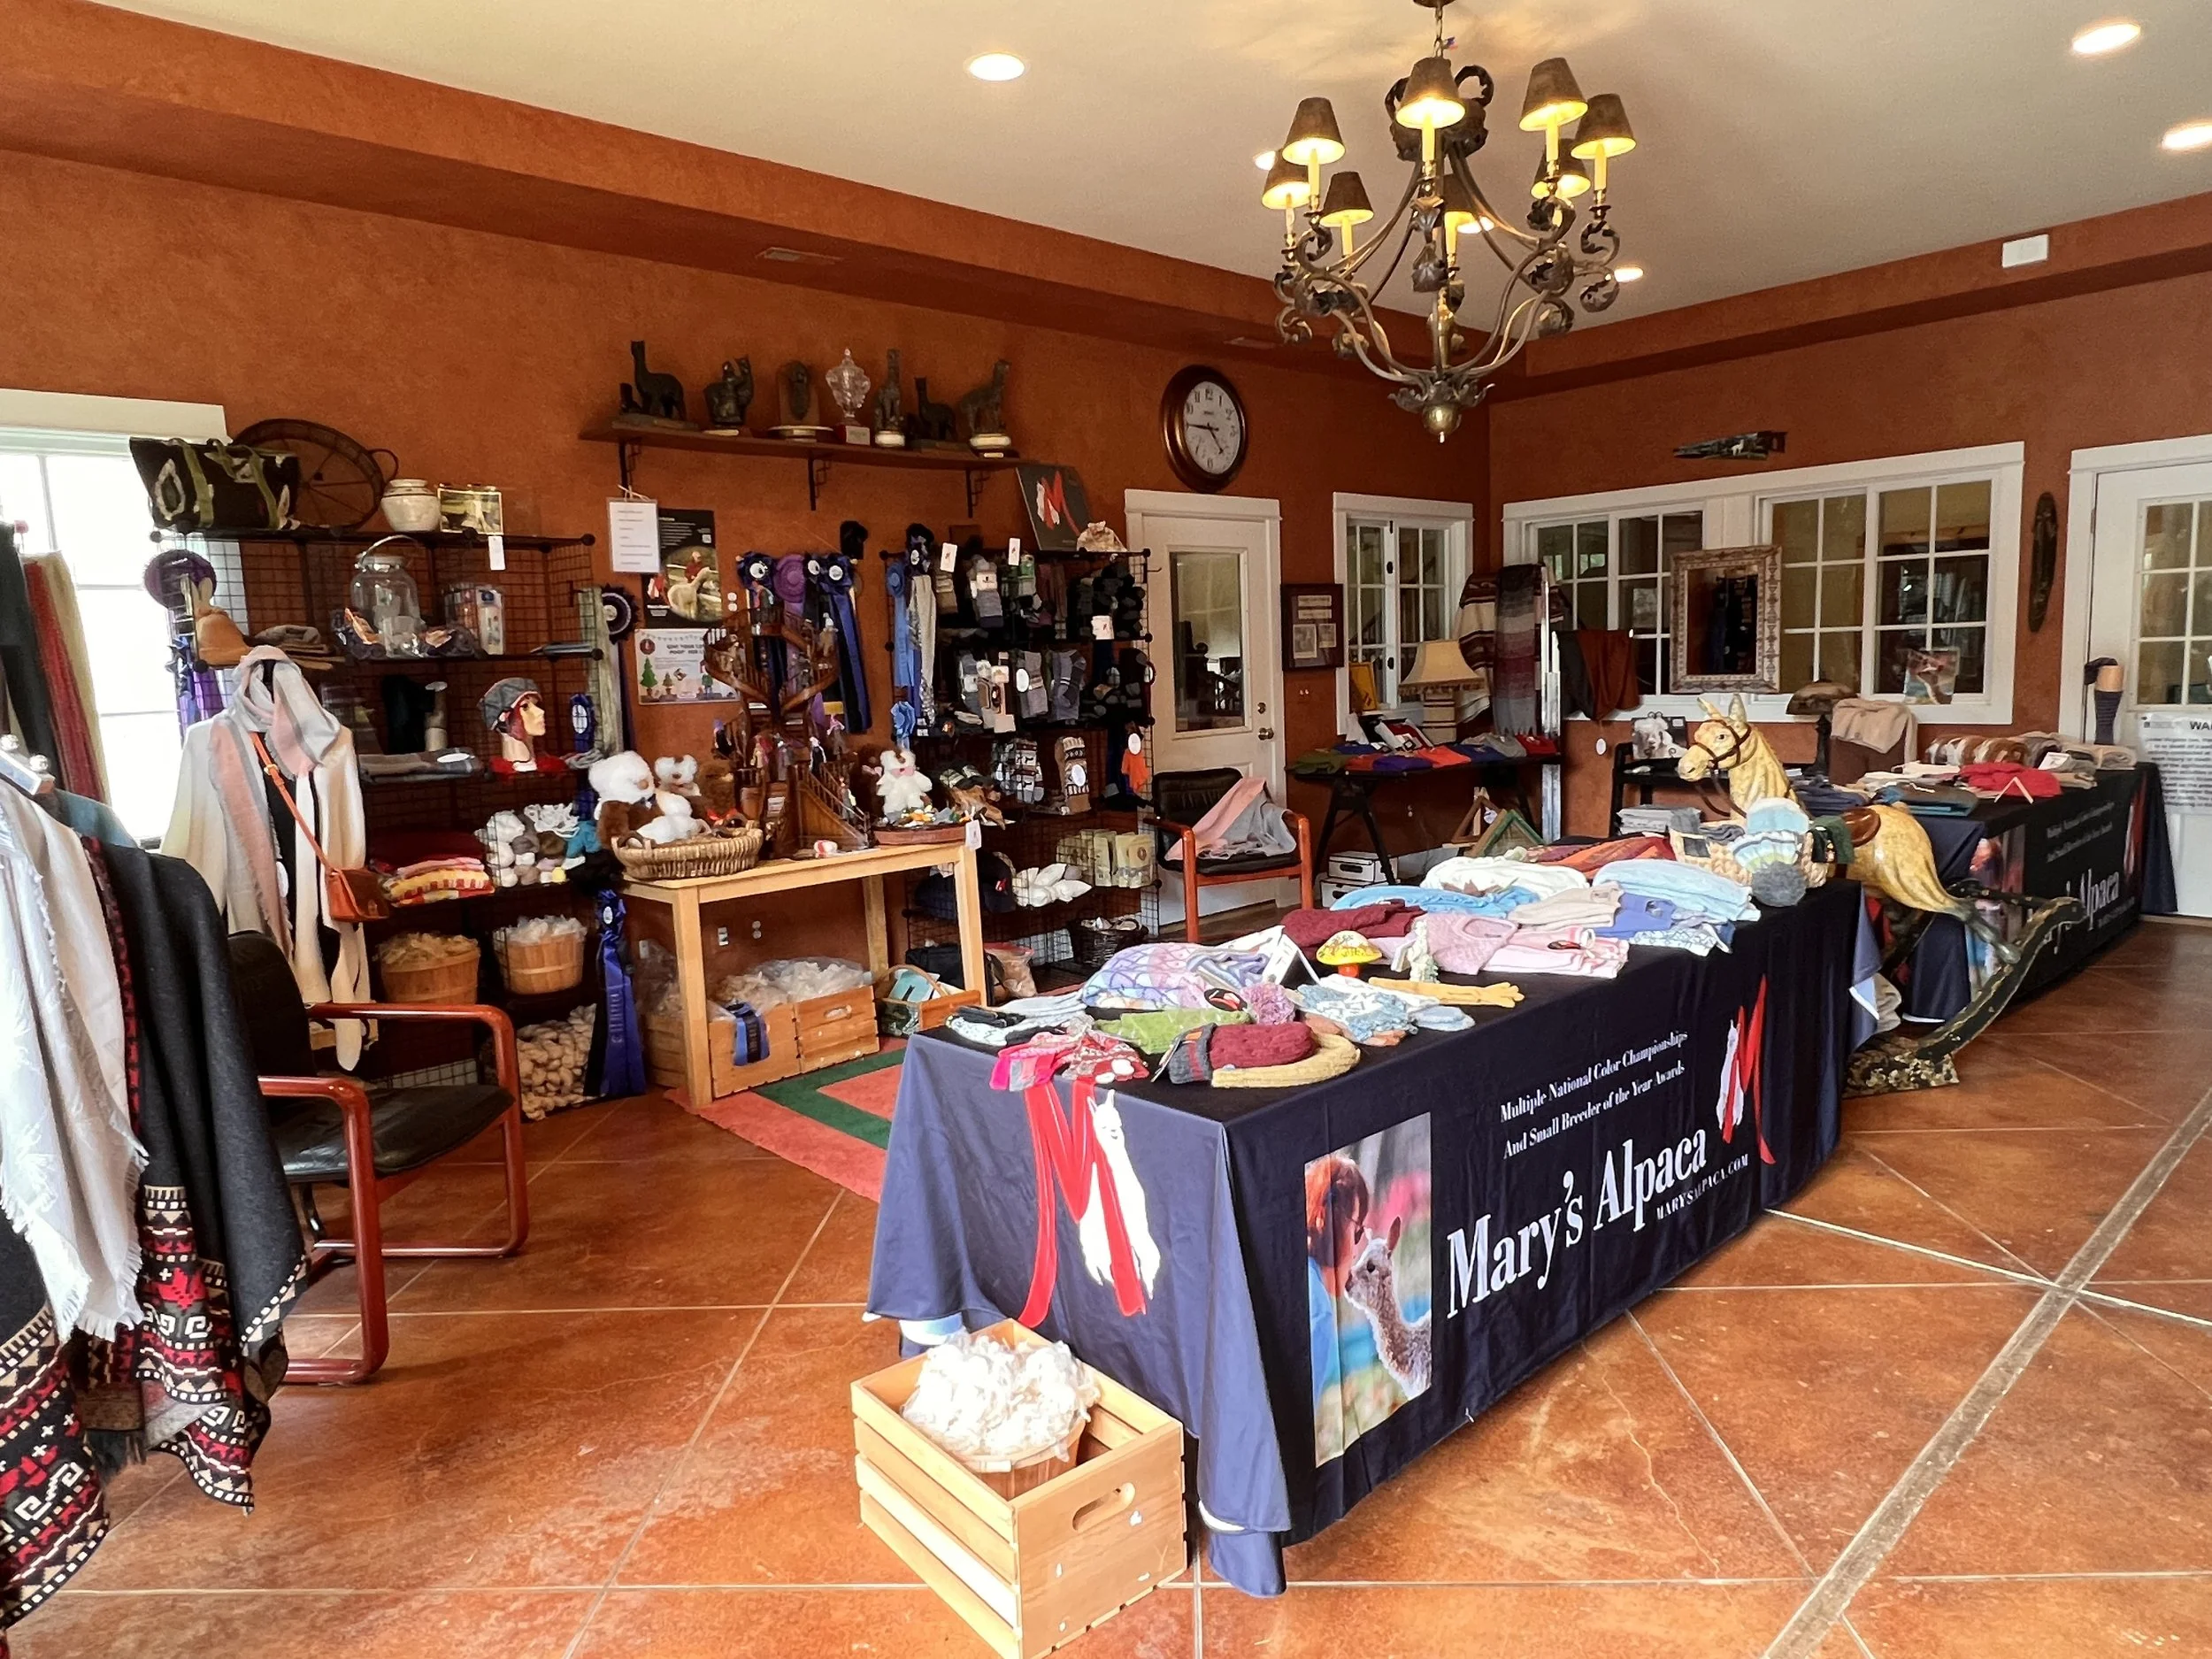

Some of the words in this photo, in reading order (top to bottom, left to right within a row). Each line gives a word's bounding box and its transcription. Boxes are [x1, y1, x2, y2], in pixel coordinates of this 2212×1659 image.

[2189, 720, 2212, 731] WA
[1501, 1088, 1547, 1123] Multiple
[1548, 1066, 1592, 1102] National
[1594, 1058, 1621, 1080] Color
[1622, 1031, 1688, 1068] Championships
[1503, 1132, 1528, 1160] And
[1529, 1117, 1559, 1147] Small
[1561, 1102, 1601, 1131] Breeder
[1602, 1091, 1615, 1110] of
[1615, 1087, 1630, 1105] the
[1632, 1078, 1653, 1096] Year
[1653, 1059, 1686, 1086] Awards
[1447, 1170, 1584, 1319] Mary's
[1593, 1129, 1708, 1233] Alpaca
